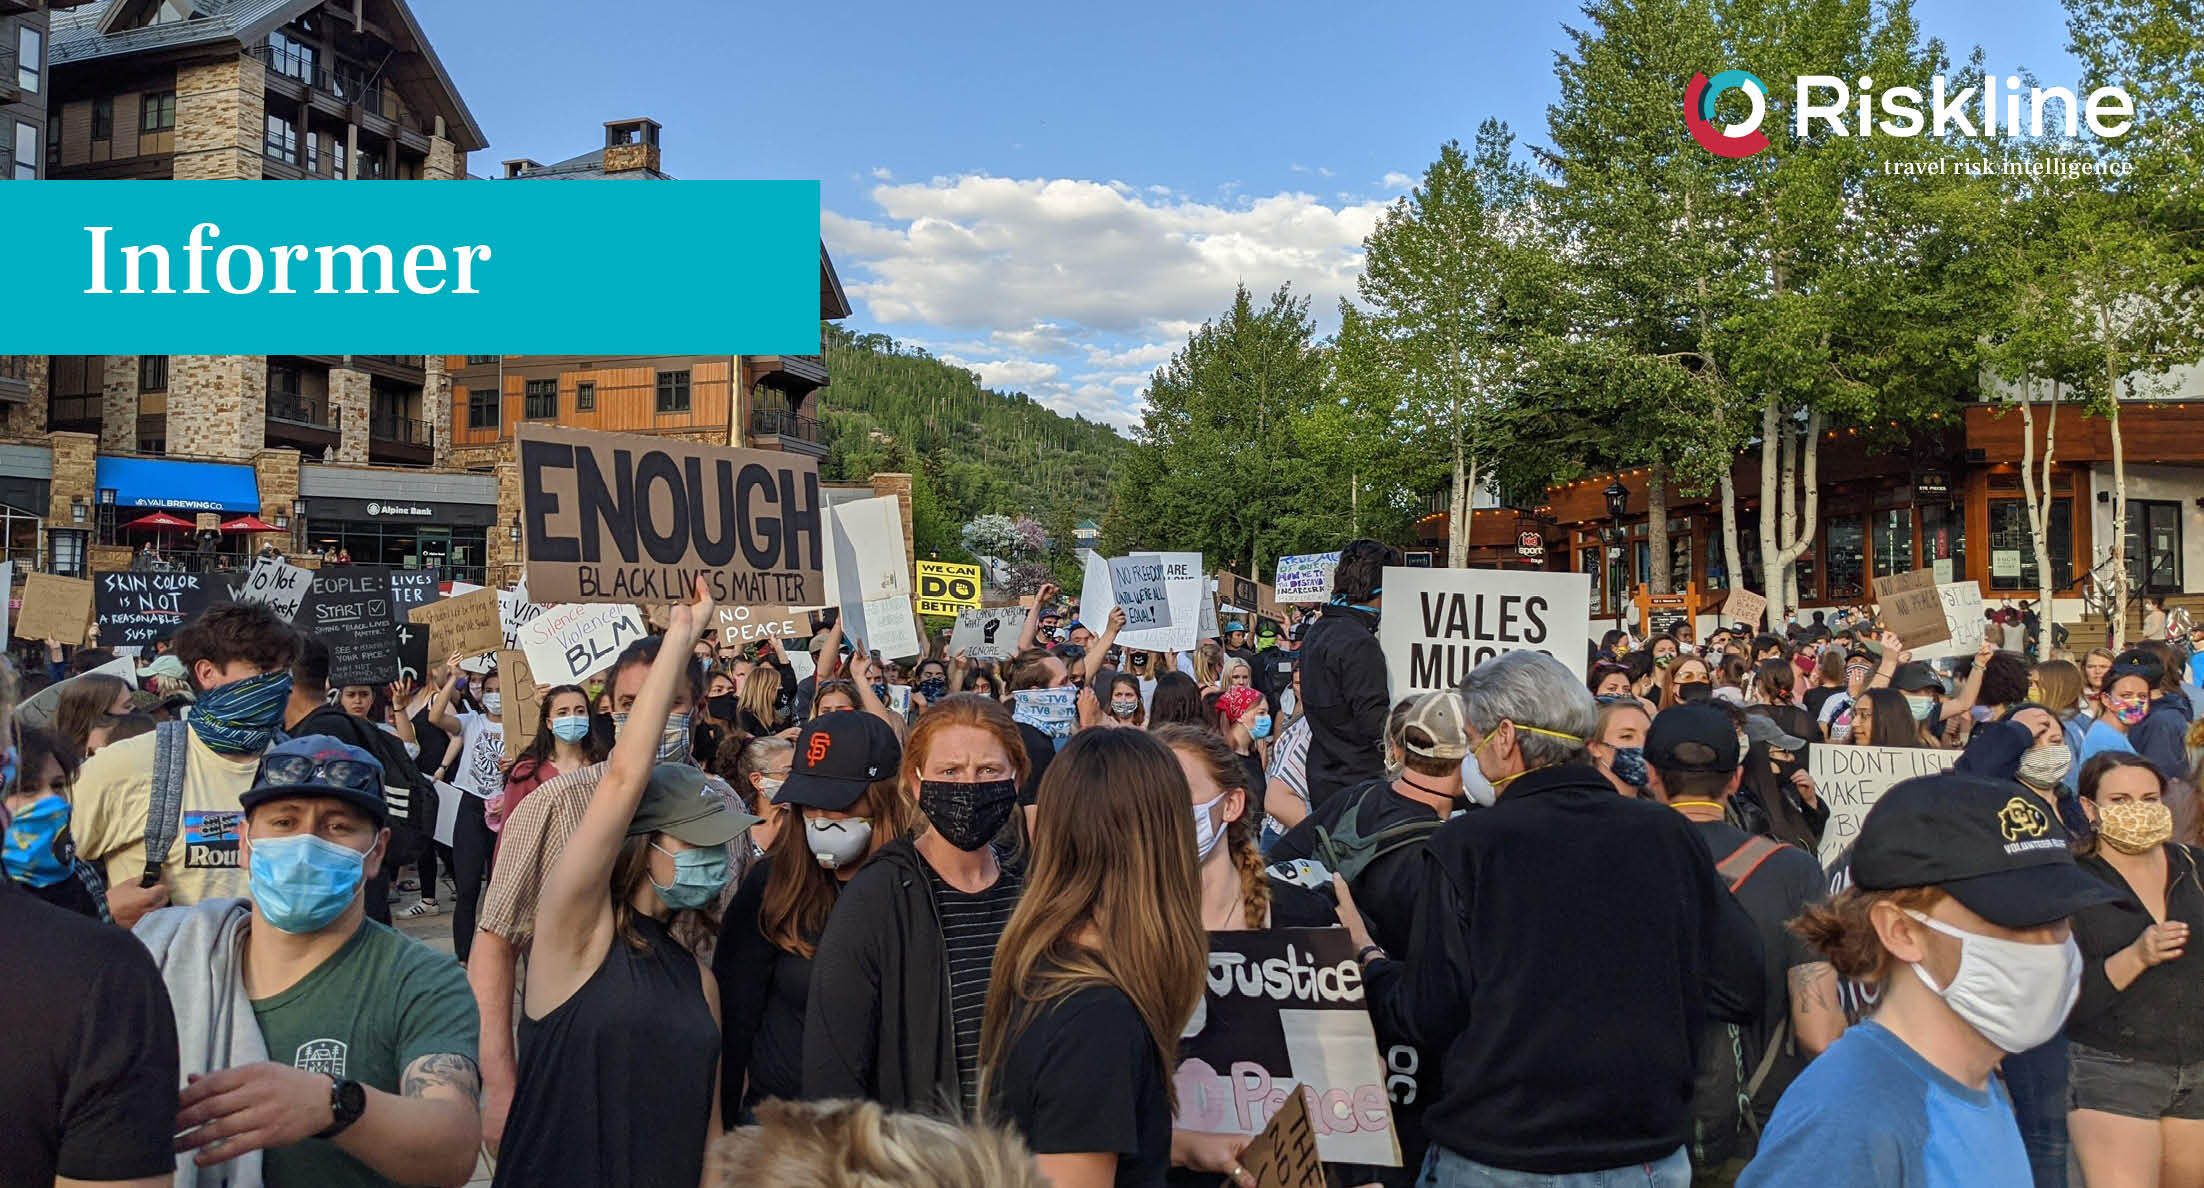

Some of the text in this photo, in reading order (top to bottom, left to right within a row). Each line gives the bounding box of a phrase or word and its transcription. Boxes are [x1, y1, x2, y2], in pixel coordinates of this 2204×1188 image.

[166, 500, 209, 510] BREWING
[381, 506, 432, 516] Alpine Bank
[522, 439, 822, 571] ENOUGH
[272, 565, 296, 590] Not
[922, 564, 976, 576] WE CAN
[1115, 567, 1132, 587] NO
[1166, 564, 1188, 576] ARE
[104, 573, 201, 592] SKIN COLOR
[312, 577, 385, 594] EOPLE:
[392, 575, 431, 586] LIVES
[579, 565, 806, 602] BLACK LIVES MATTER
[921, 576, 976, 600] DO
[138, 592, 183, 613] NOT
[391, 588, 424, 603] TER
[1114, 591, 1135, 605] UNTIL
[1153, 586, 1166, 601] ALL
[99, 613, 183, 625] A REASONABLE
[315, 602, 365, 619] START
[719, 607, 750, 625] NO
[1420, 591, 1548, 644] VALES
[125, 627, 158, 642] SUSP
[533, 606, 585, 645] Silence
[726, 620, 798, 643] PEACE
[565, 615, 640, 678] BLM
[967, 646, 1000, 656] IGNORE
[1046, 695, 1068, 703] TV8
[1030, 706, 1050, 715] TV8
[1818, 749, 1823, 776] I
[1832, 748, 1901, 776] DON'T
[1815, 779, 1875, 806] MAKE
[1206, 943, 1365, 1003] Justice
